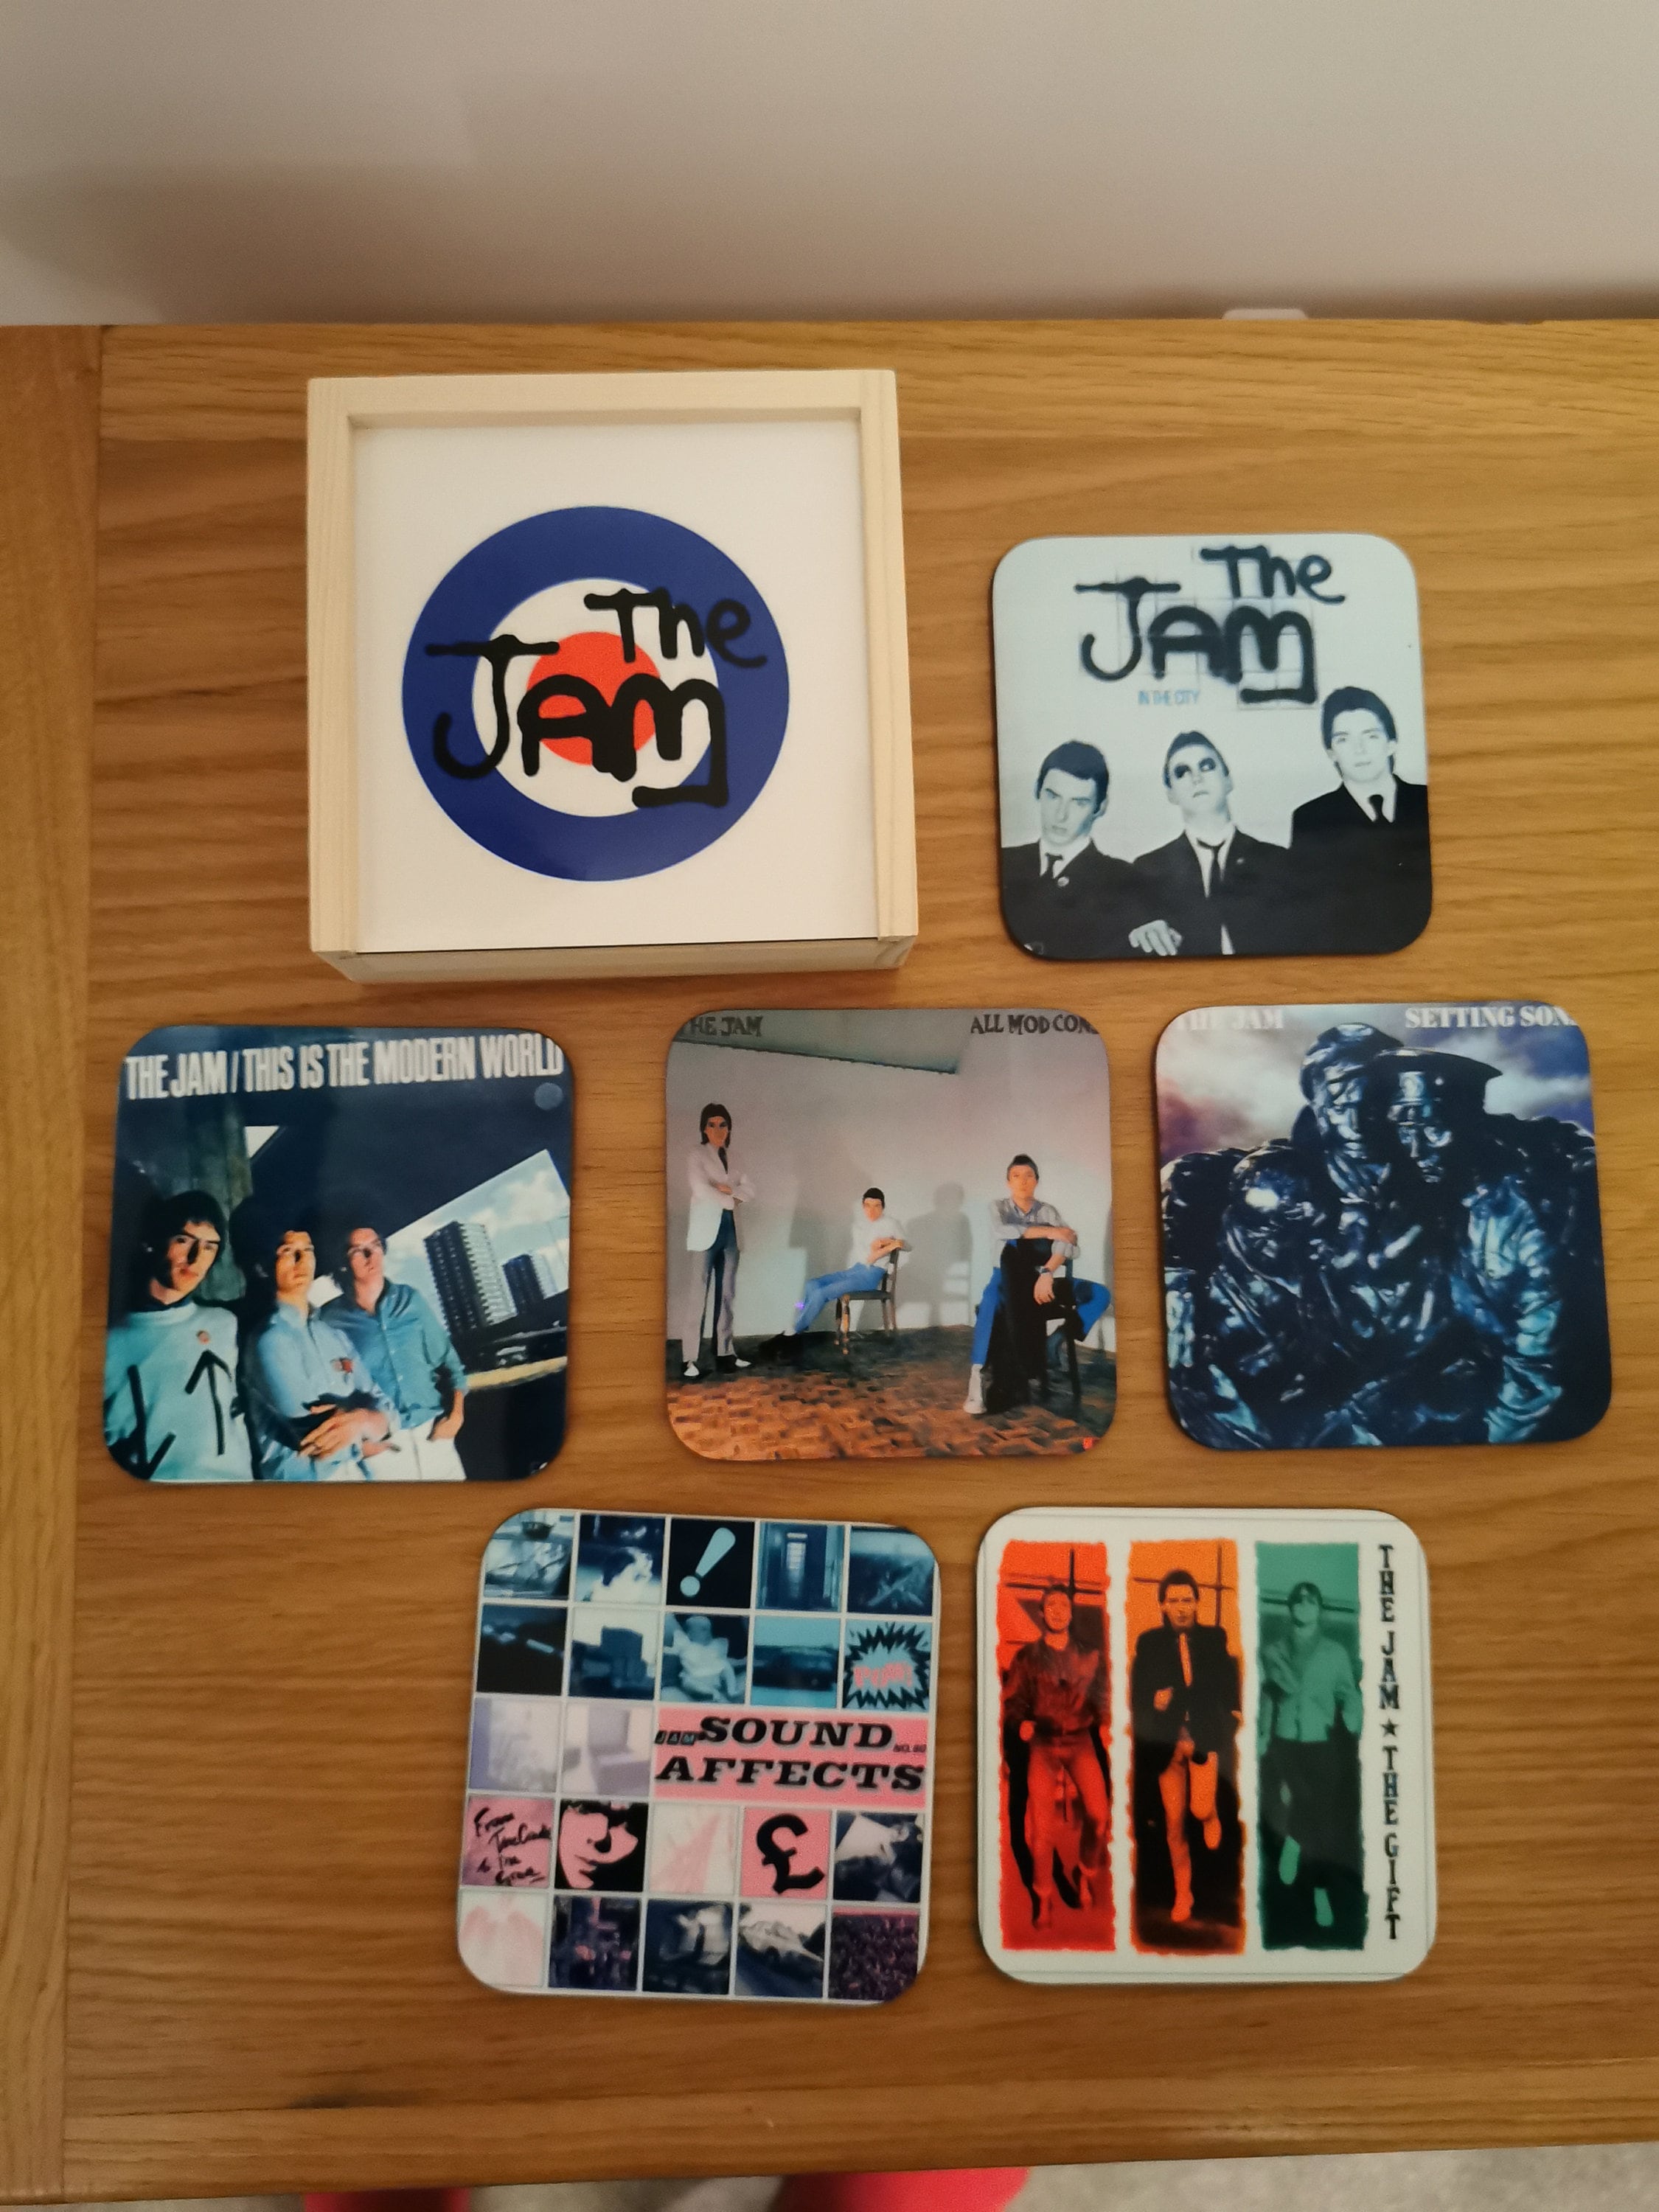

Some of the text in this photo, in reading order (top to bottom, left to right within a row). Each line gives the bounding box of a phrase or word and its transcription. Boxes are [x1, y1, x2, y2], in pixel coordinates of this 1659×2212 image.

[1200, 545, 1346, 604] The
[584, 587, 768, 669] The
[677, 1015, 764, 1037] HE JAM
[970, 1014, 1004, 1034] ALL
[1008, 1014, 1050, 1035] MOD
[1405, 1006, 1515, 1029] SETTING
[125, 1054, 169, 1099] THE
[170, 1050, 227, 1098] JAM
[242, 1046, 295, 1093] THIS
[299, 1044, 324, 1089] IS
[326, 1042, 370, 1087] THE
[373, 1036, 476, 1085] MODERN
[479, 1032, 564, 1079] WORLD
[700, 1715, 892, 1748] SOUND
[1377, 1544, 1401, 1939] THE JAM THE GIFT
[655, 1755, 925, 1790] AFFECTS
